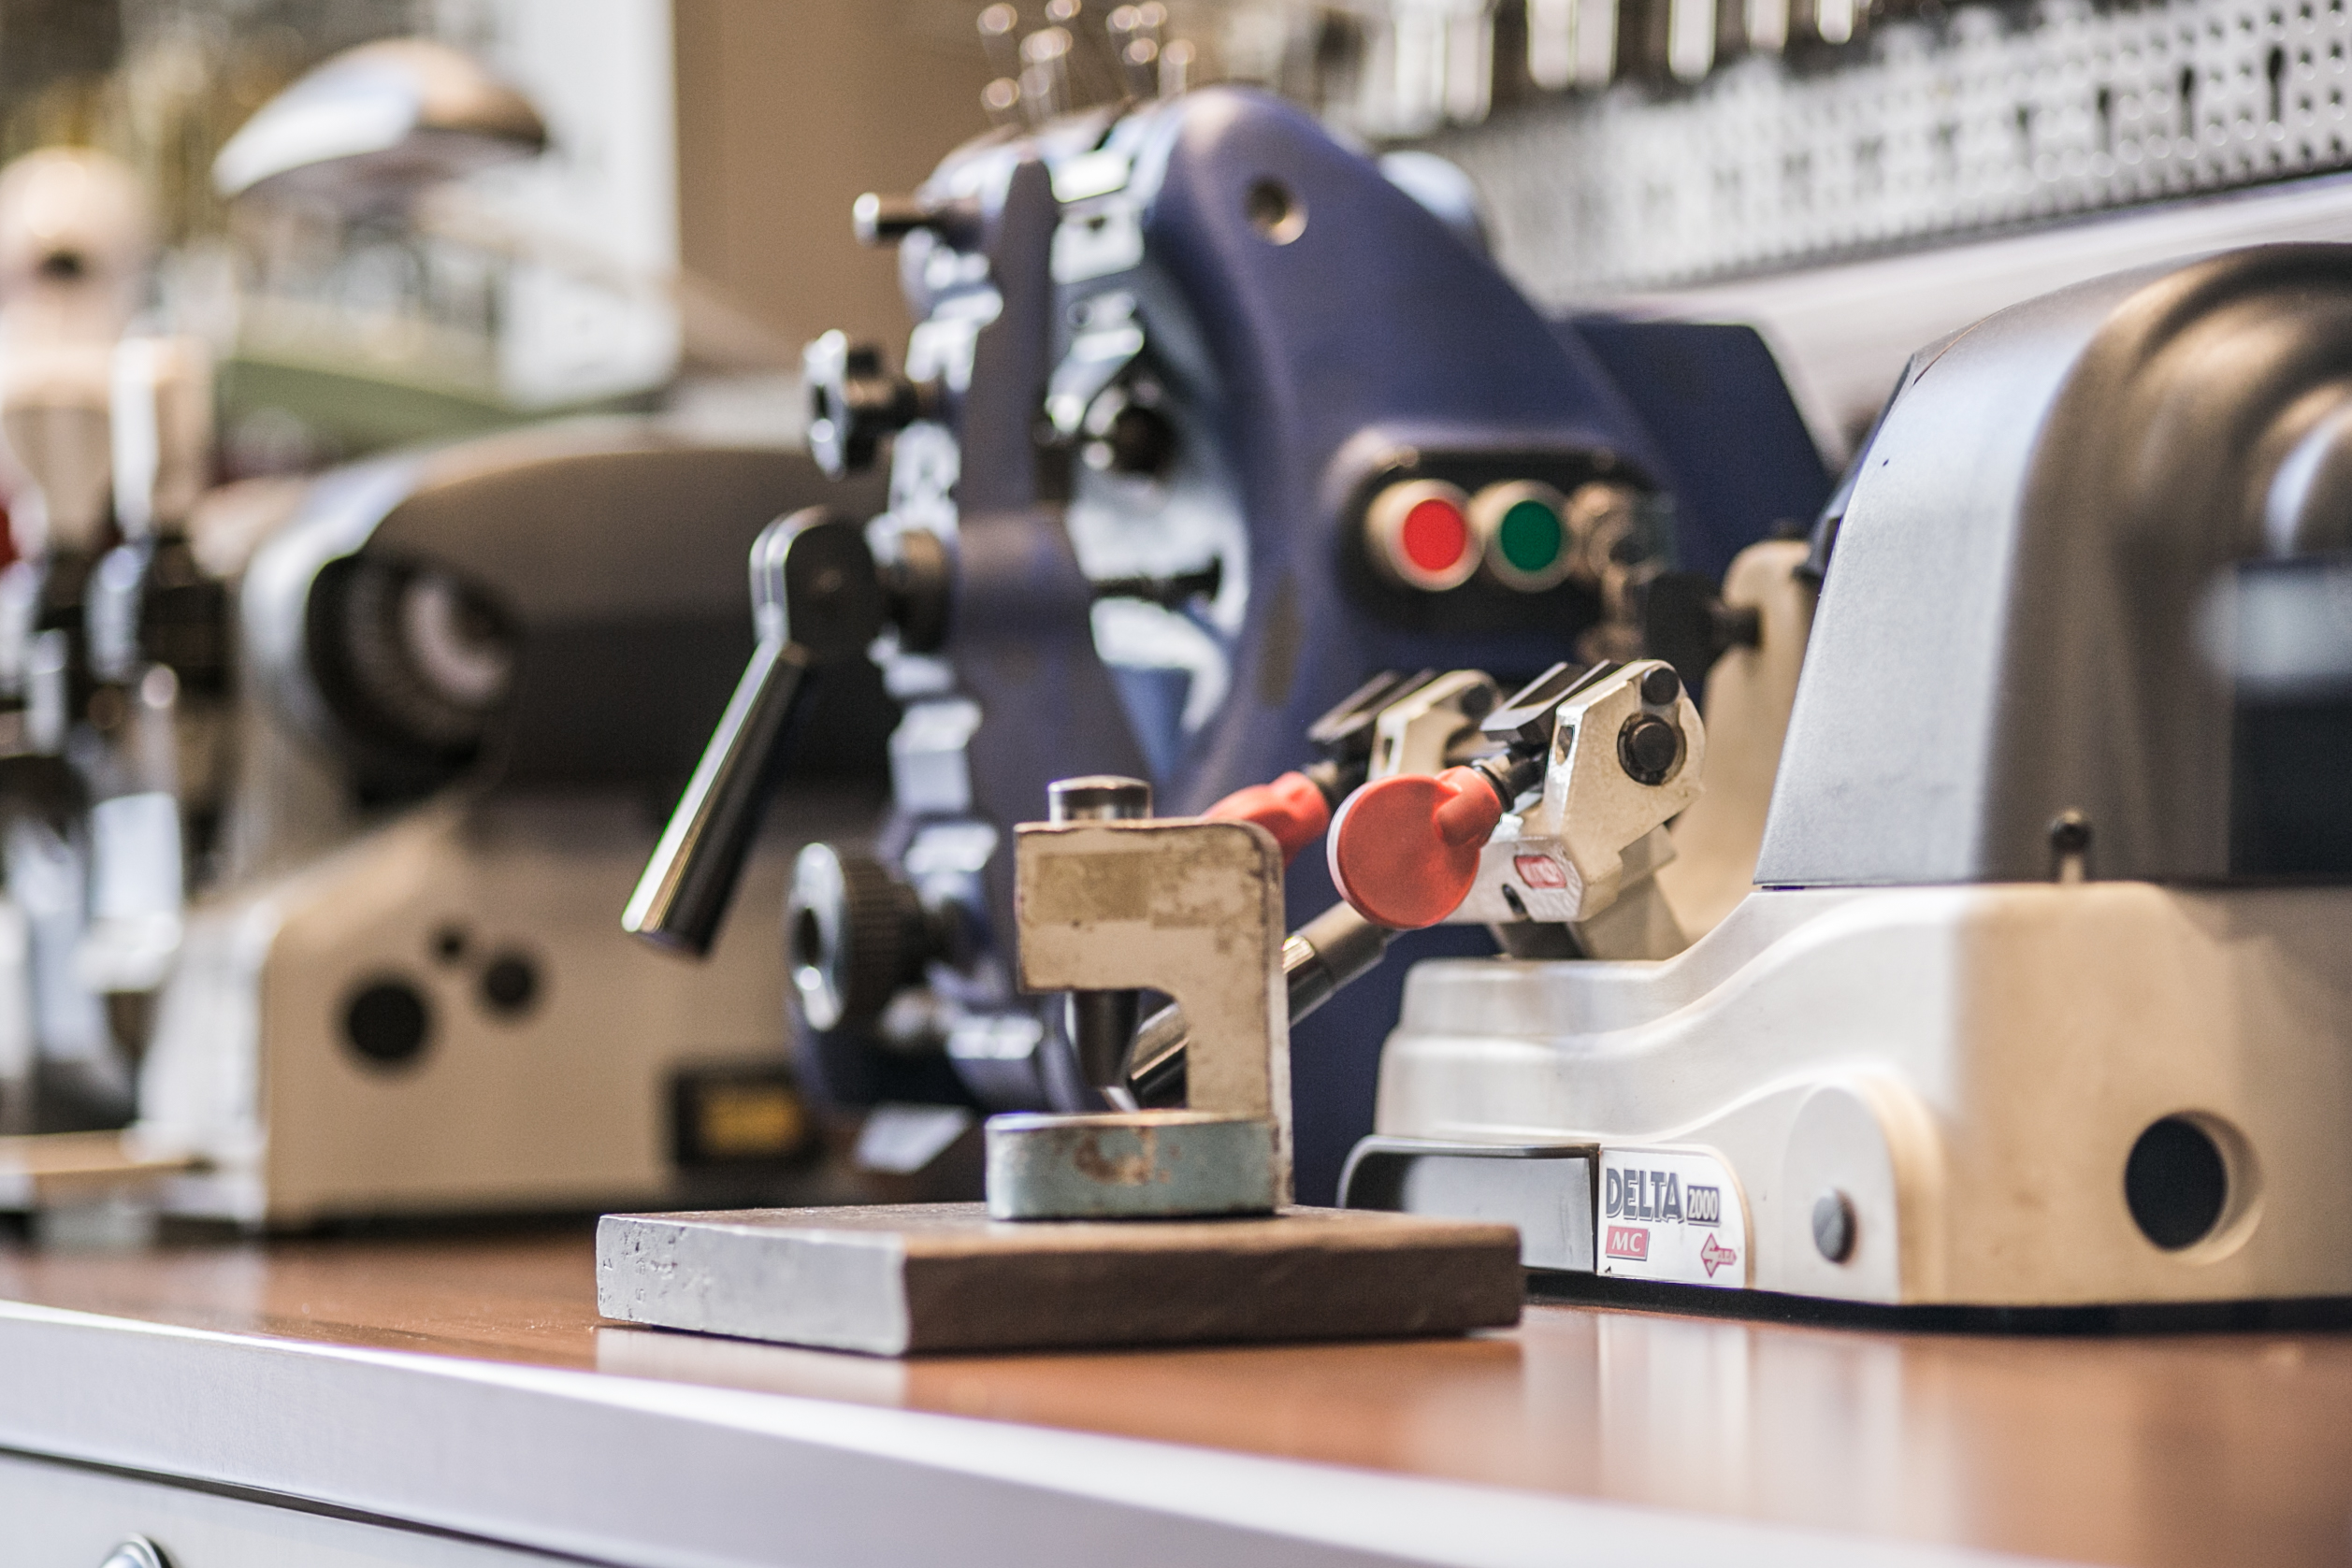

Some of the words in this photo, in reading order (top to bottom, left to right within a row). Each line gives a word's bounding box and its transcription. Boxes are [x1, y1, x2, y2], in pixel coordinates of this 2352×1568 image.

[1606, 1168, 1684, 1224] DELTA
[1687, 1187, 1719, 1222] 2000
[1610, 1230, 1643, 1253] MC
